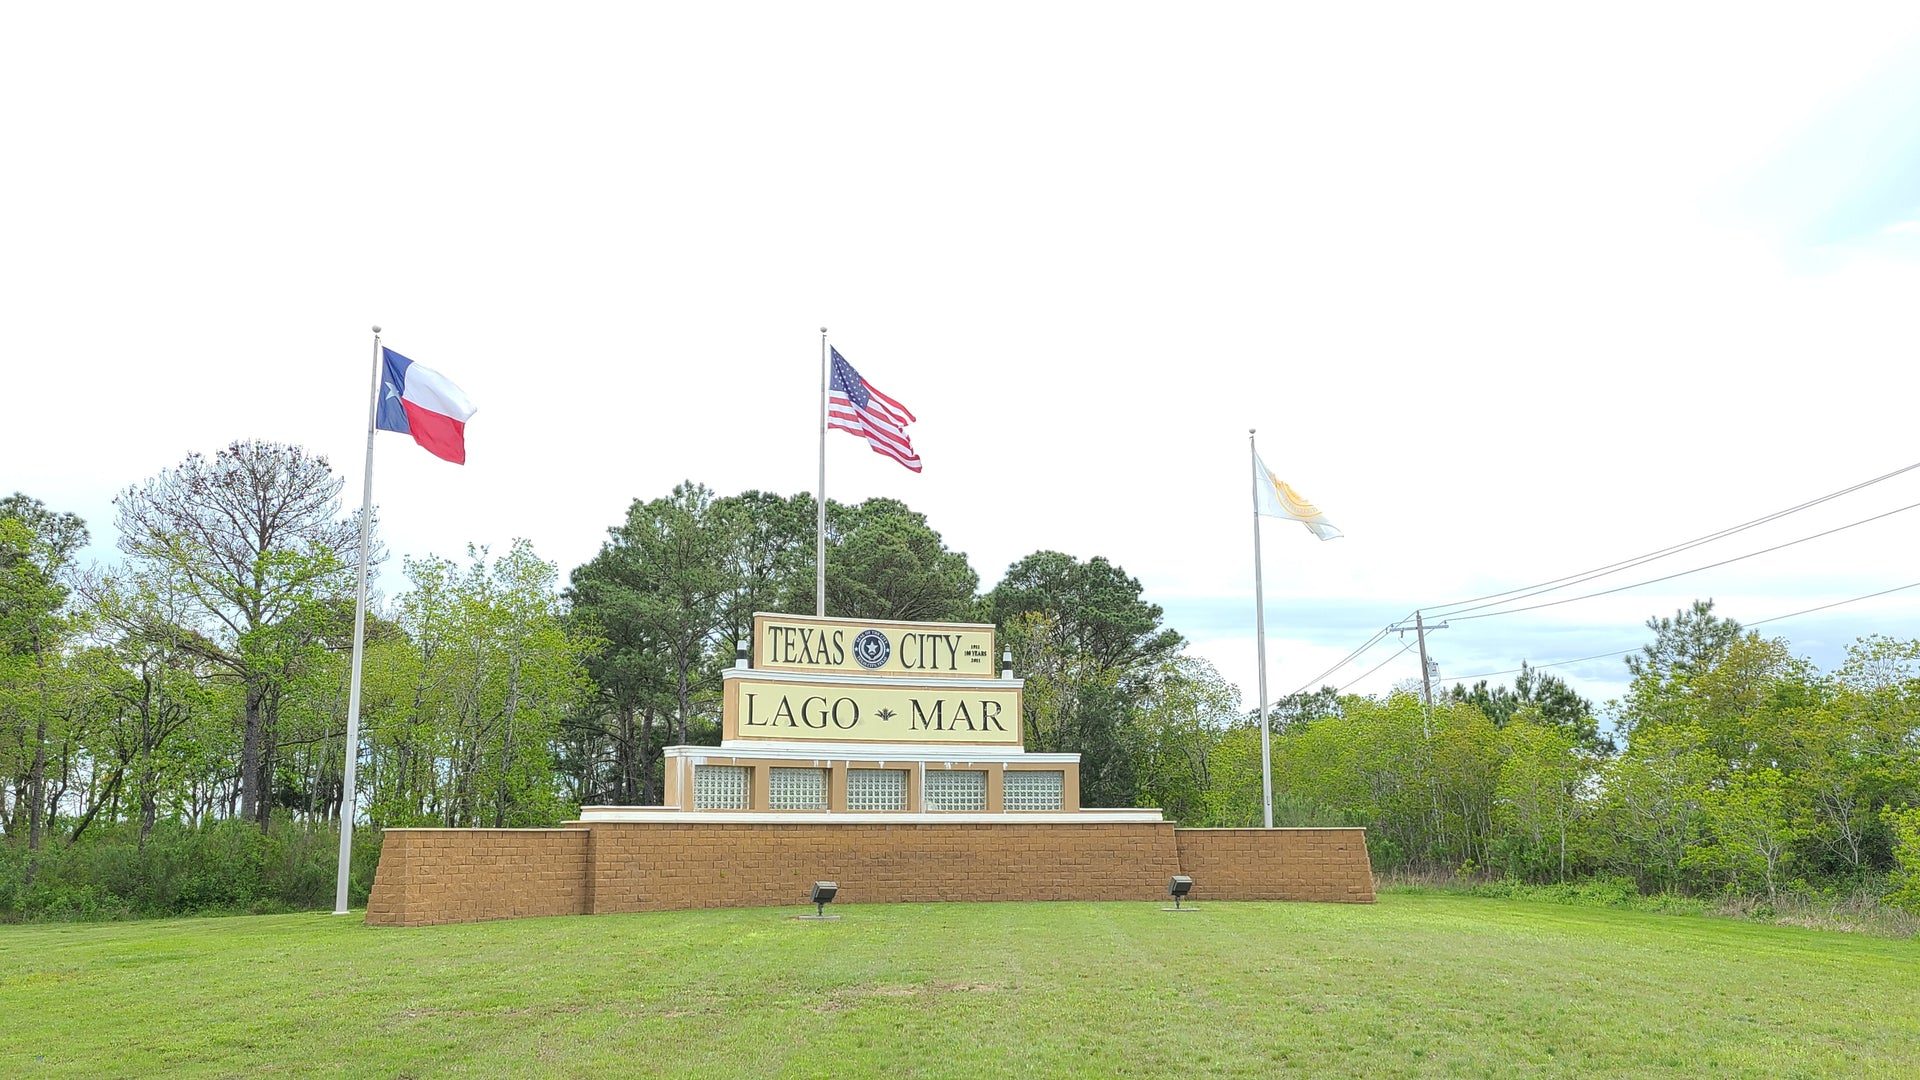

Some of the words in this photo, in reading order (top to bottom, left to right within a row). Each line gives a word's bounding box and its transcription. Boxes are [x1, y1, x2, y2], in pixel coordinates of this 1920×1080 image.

[768, 625, 845, 666] TEXAS
[900, 633, 962, 670] CITY
[744, 693, 860, 730] LAGO
[908, 699, 1008, 731] MAR
